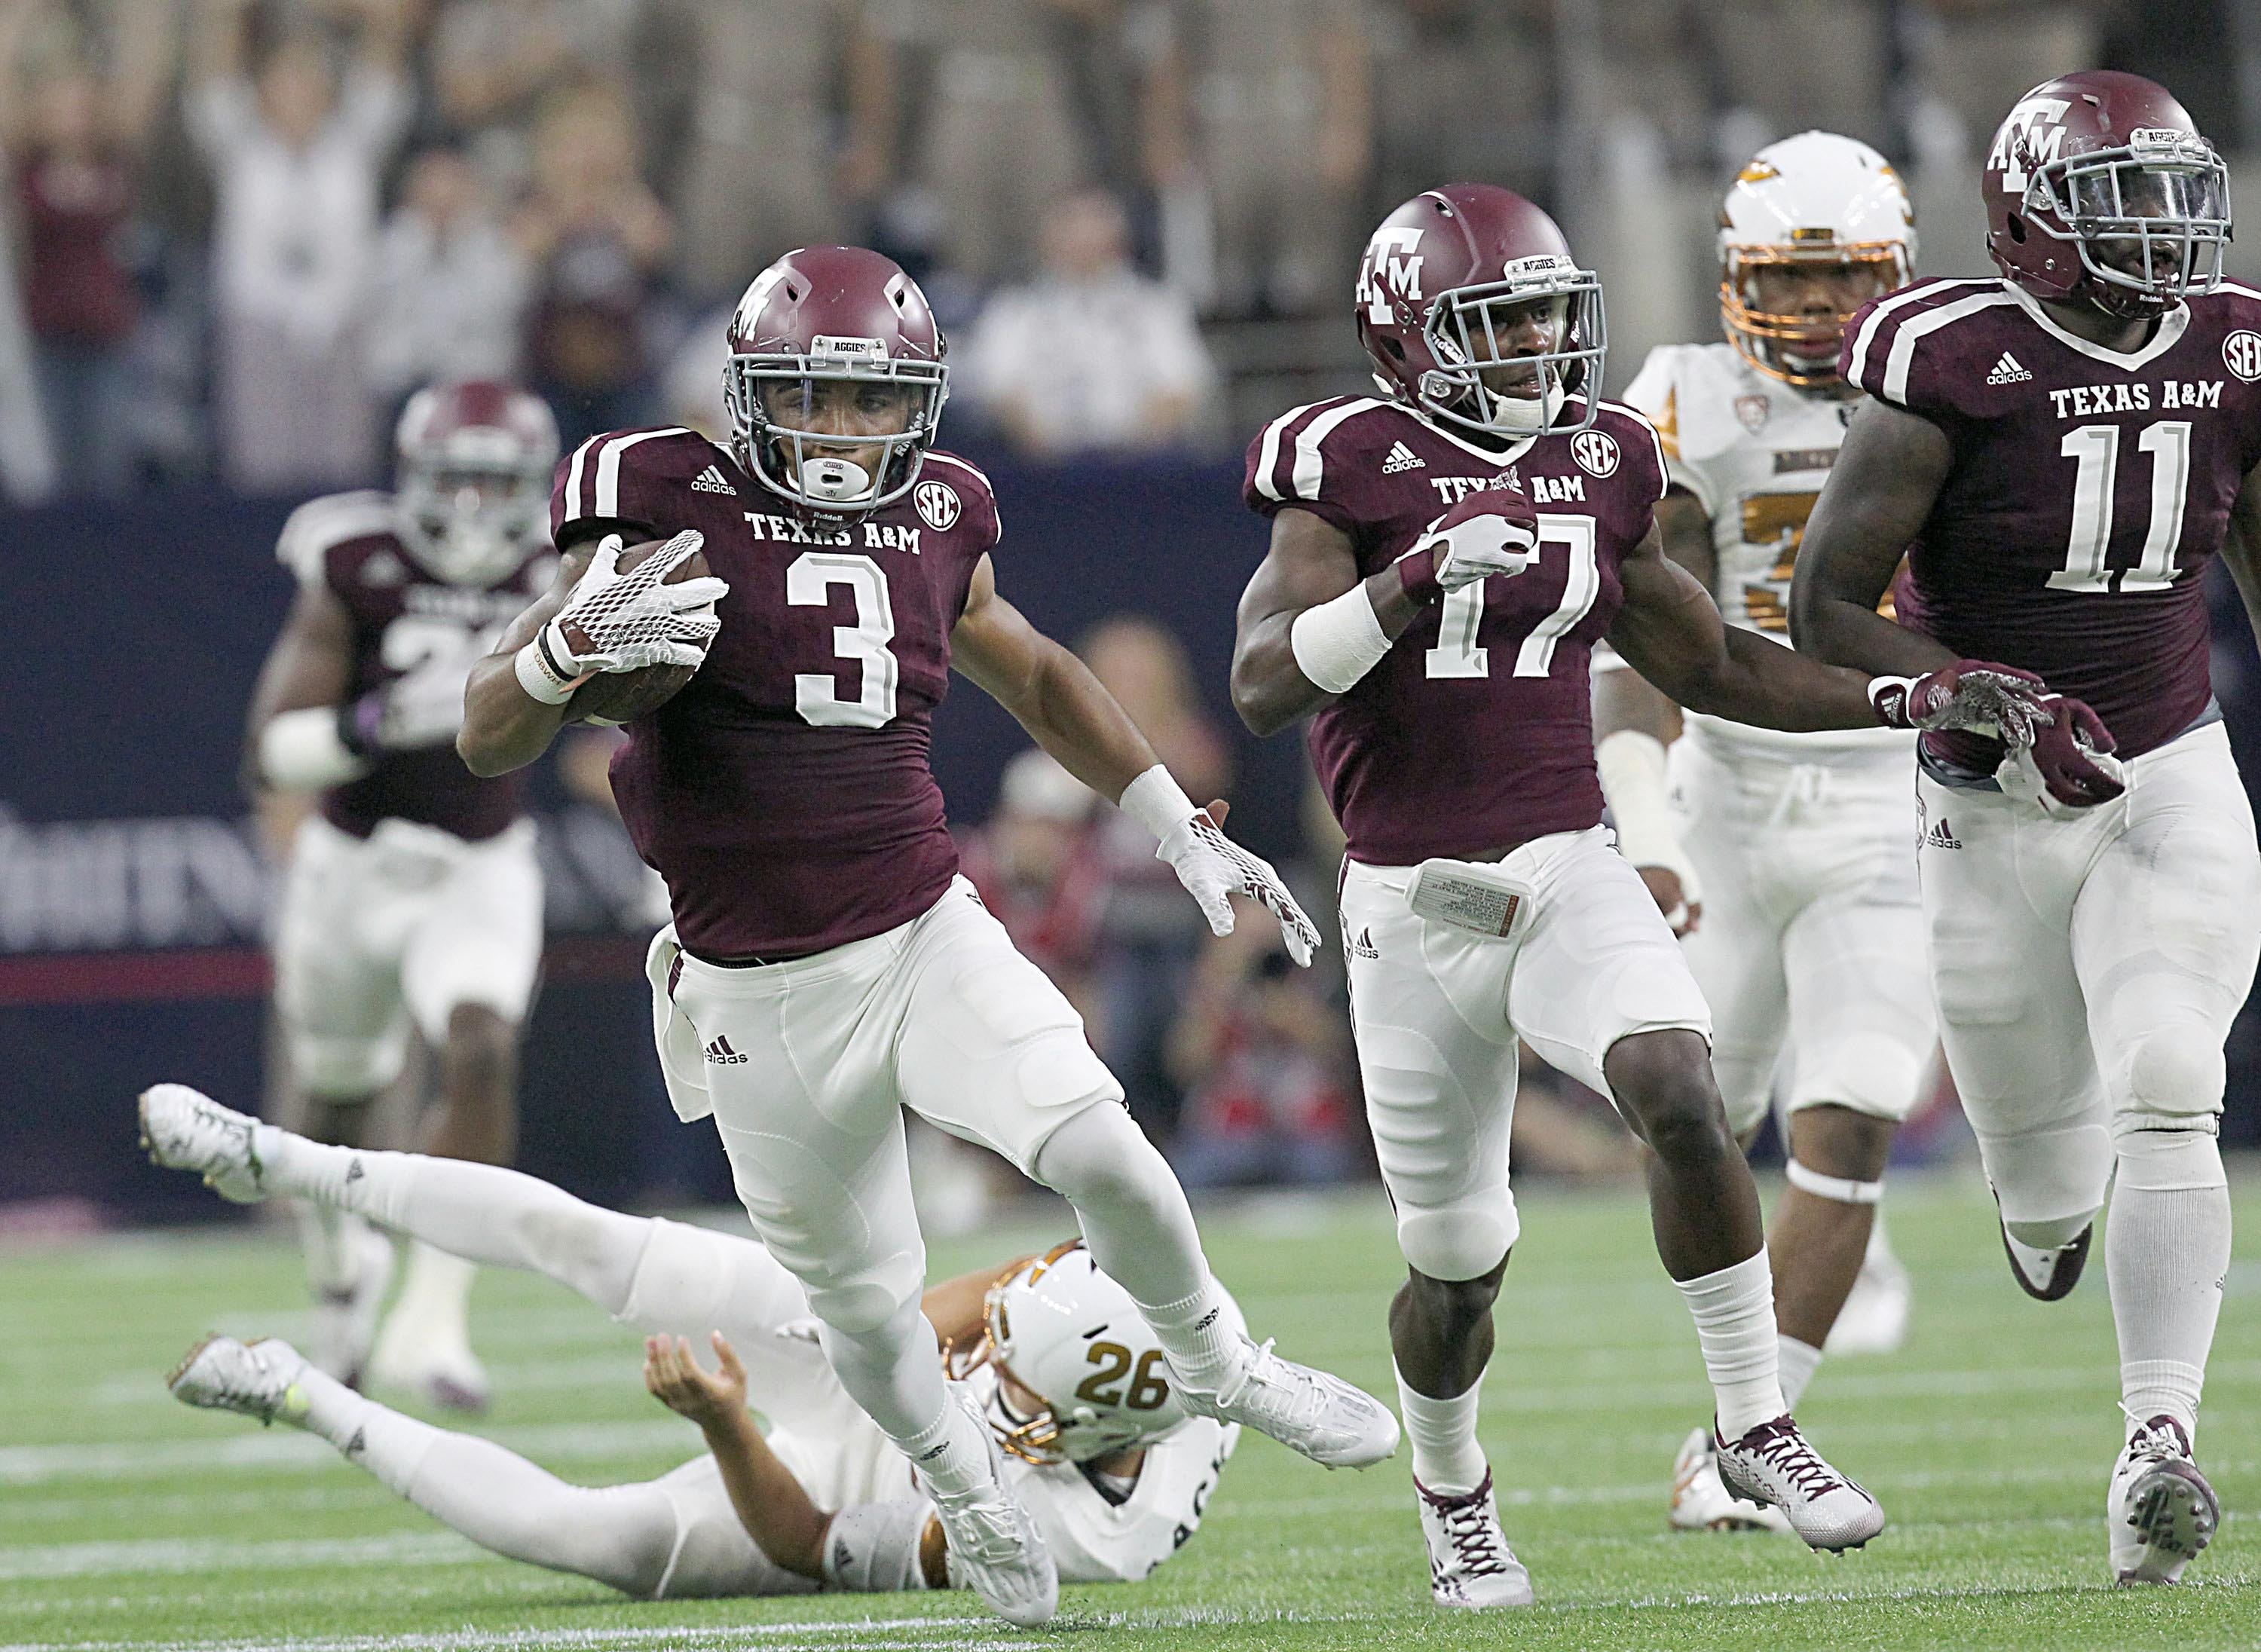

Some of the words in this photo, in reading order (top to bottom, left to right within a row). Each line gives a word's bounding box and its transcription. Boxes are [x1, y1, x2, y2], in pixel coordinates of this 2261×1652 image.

[2149, 132, 2183, 142] AGGIE
[1523, 259, 1556, 271] AGGIES
[834, 342, 866, 353] AGGIES
[1431, 332, 1467, 365] iddell
[1987, 369, 2033, 385] adidas
[2048, 383, 2150, 418] TEXAS
[2162, 380, 2224, 408] A&M
[1382, 457, 1426, 474] adidas
[1574, 433, 1615, 474] SEC
[691, 480, 737, 496] adidas
[1430, 476, 1524, 504] TEX
[1530, 475, 1586, 503] A&M
[814, 511, 843, 522] Riddell
[920, 485, 956, 527] SEC
[2044, 421, 2192, 592] 11
[863, 522, 921, 555] A&M
[1426, 513, 1600, 678] 17
[787, 552, 897, 730] 3
[534, 653, 561, 685] DBWH
[1075, 1341, 1168, 1410] 26
